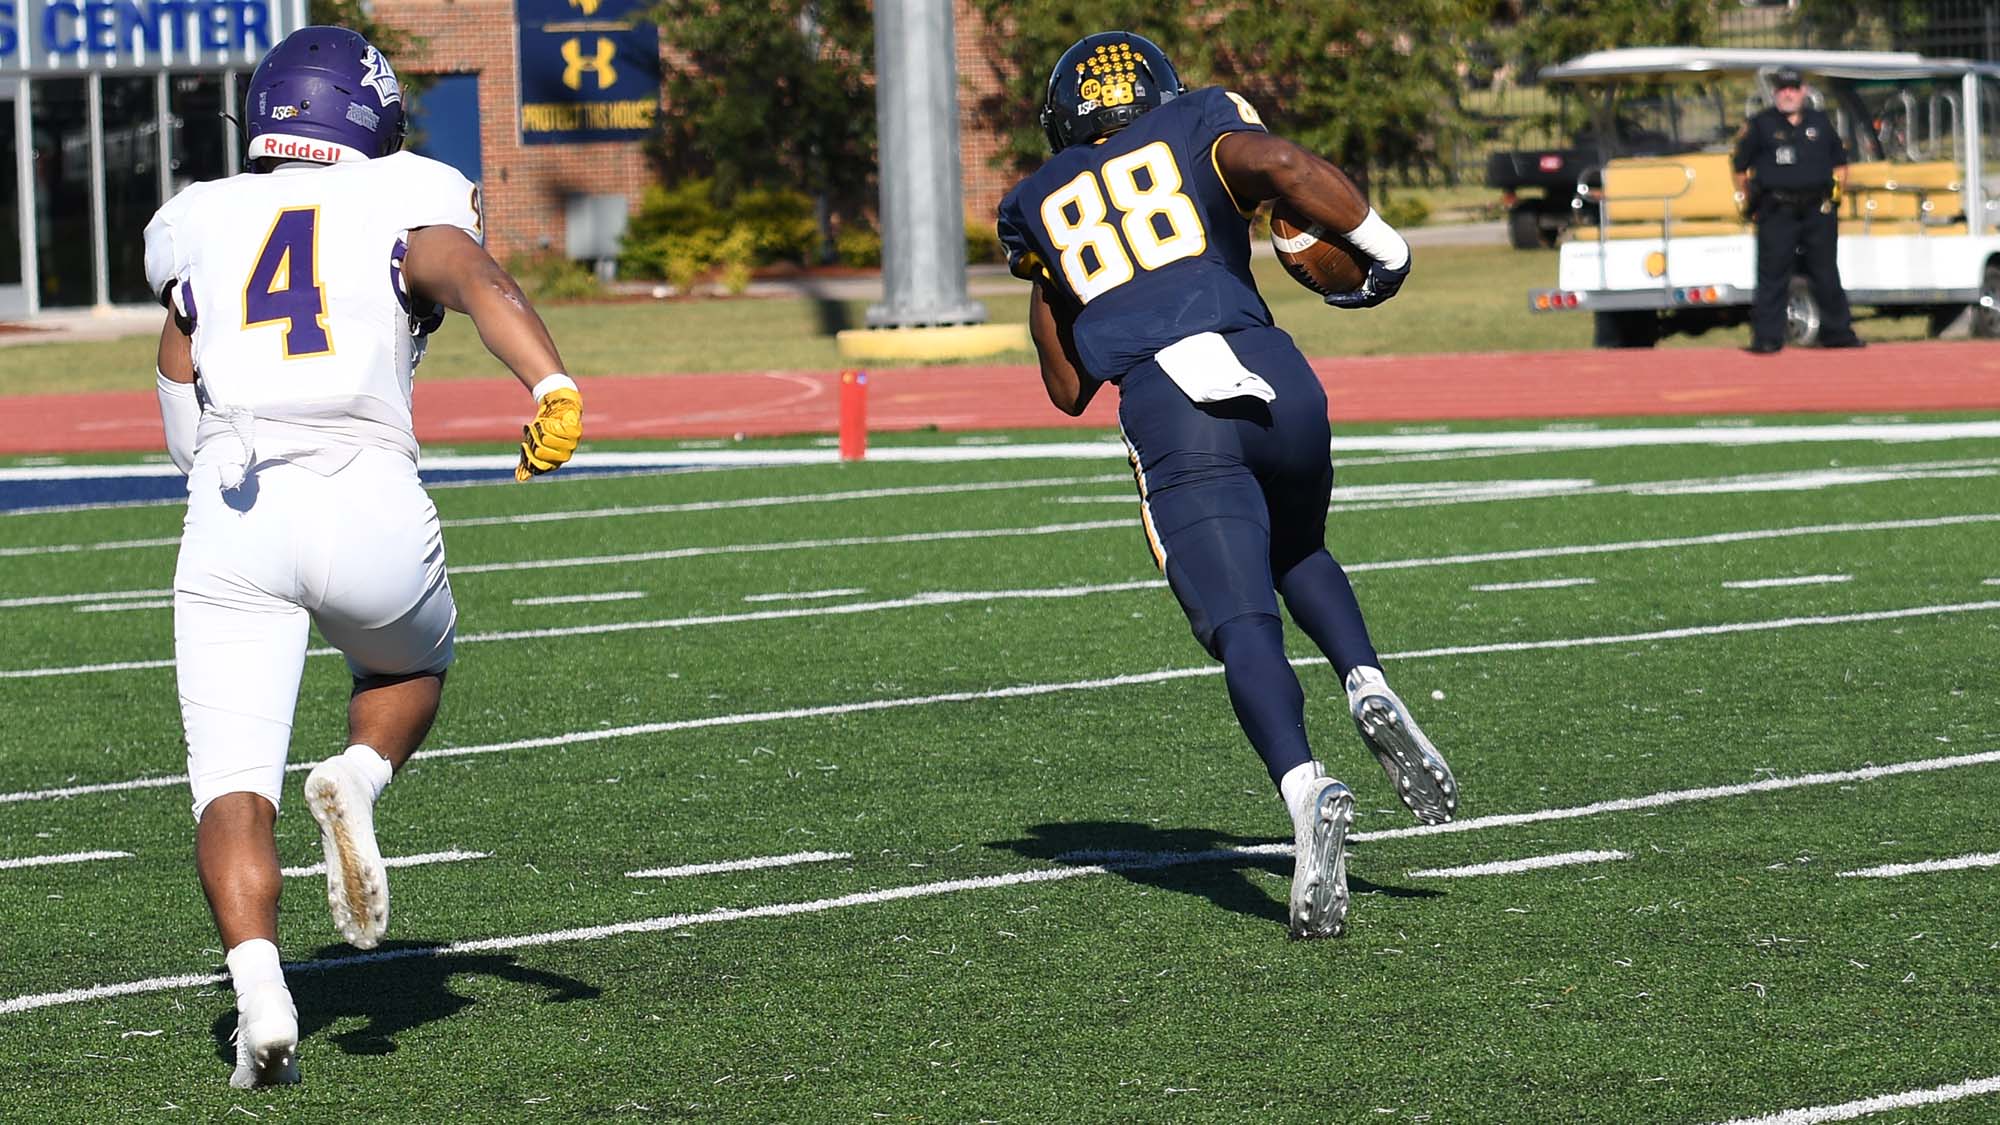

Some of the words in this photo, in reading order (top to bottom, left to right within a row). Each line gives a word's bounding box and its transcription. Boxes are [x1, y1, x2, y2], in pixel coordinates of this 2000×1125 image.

[42, 1, 269, 54] CENTER
[1084, 82, 1098, 96] GC
[1101, 82, 1134, 107] 88
[521, 102, 584, 132] PROTECT
[585, 101, 608, 129] THIS
[264, 138, 341, 162] Riddell
[1041, 141, 1206, 305] 88
[241, 204, 336, 360] 4
